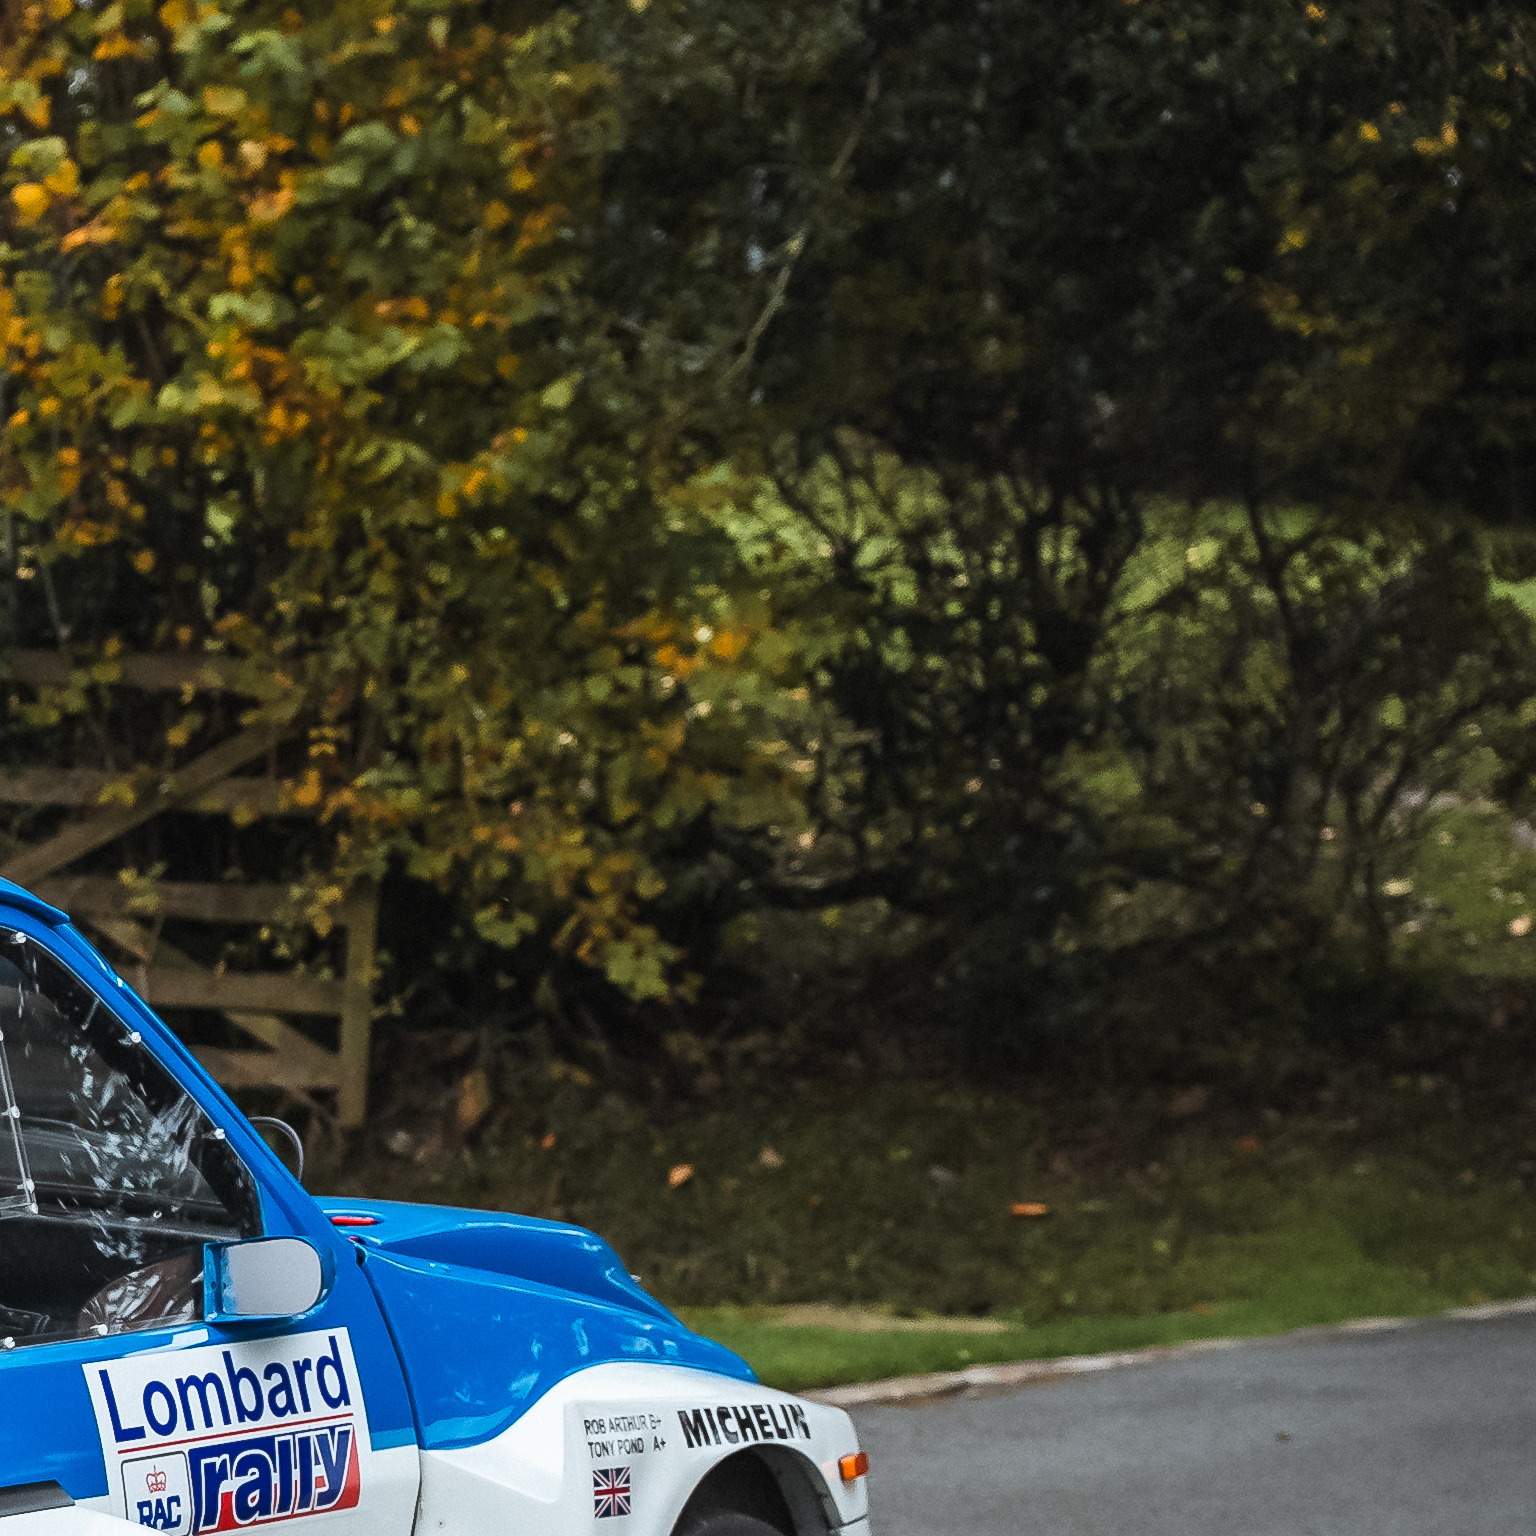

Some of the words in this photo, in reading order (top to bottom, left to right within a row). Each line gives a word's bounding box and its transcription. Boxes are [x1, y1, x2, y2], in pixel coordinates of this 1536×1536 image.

[98, 1335, 351, 1443] Lombard
[584, 1418, 607, 1436] ROB
[609, 1414, 648, 1434] ARTHUR
[678, 1404, 811, 1449] MICHELIN
[588, 1440, 615, 1459] TONY
[618, 1438, 645, 1454] POND
[200, 1427, 352, 1528] rally
[136, 1495, 182, 1531] RAC
